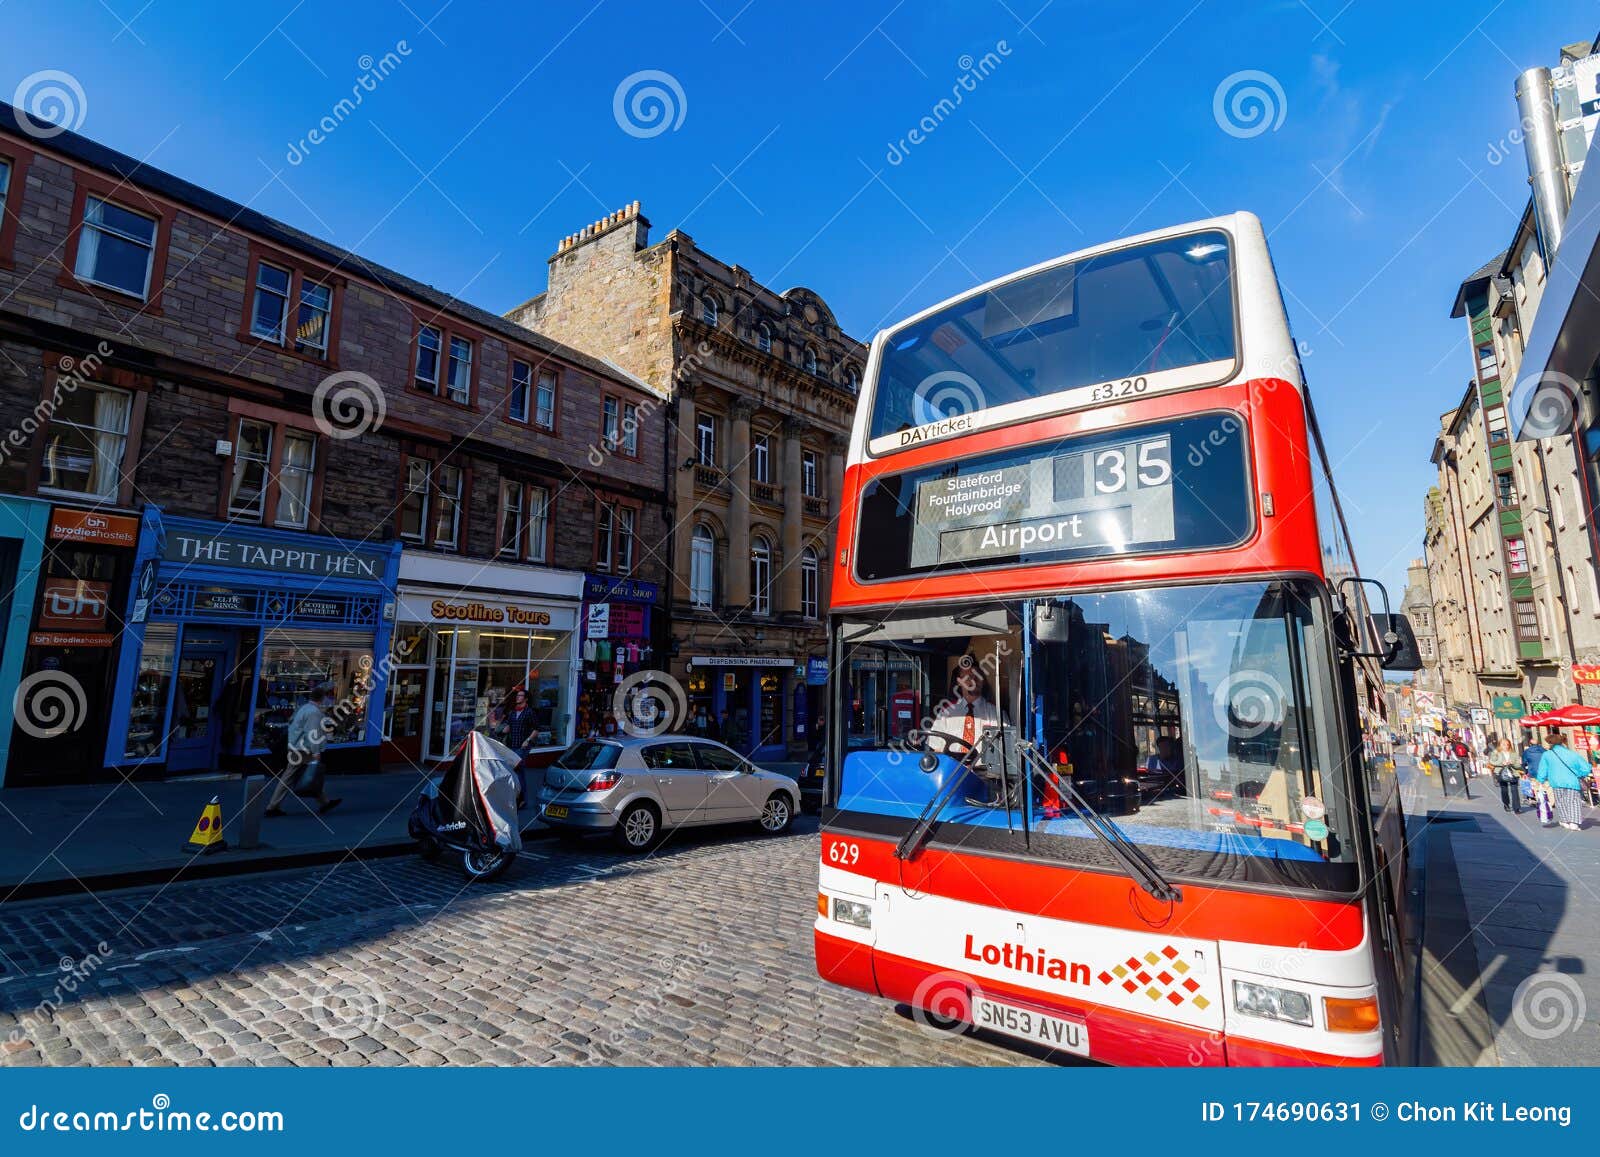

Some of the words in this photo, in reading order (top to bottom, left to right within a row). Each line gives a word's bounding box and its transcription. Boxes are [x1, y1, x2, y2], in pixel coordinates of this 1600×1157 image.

[1091, 377, 1147, 401] £3.20
[900, 415, 973, 445] DAYticket
[1095, 440, 1171, 493] 35
[947, 471, 1003, 491] Slateford
[929, 482, 1021, 507] Fountainbridge
[945, 498, 1001, 517] Holyrood
[981, 514, 1082, 549] Airport
[176, 537, 231, 561] THE
[237, 543, 321, 570] TAPPIT
[325, 555, 376, 576] HEN
[51, 591, 99, 616] bh
[632, 589, 653, 599] SHOP
[431, 600, 504, 622] Scotline
[506, 606, 550, 625] Tours
[709, 657, 748, 665] DISPENSING
[749, 658, 781, 666] PHARMACY
[830, 841, 859, 865] 629
[964, 934, 1091, 986] Lothian
[981, 1002, 1032, 1034] SN53
[1038, 1017, 1080, 1047] AVU
